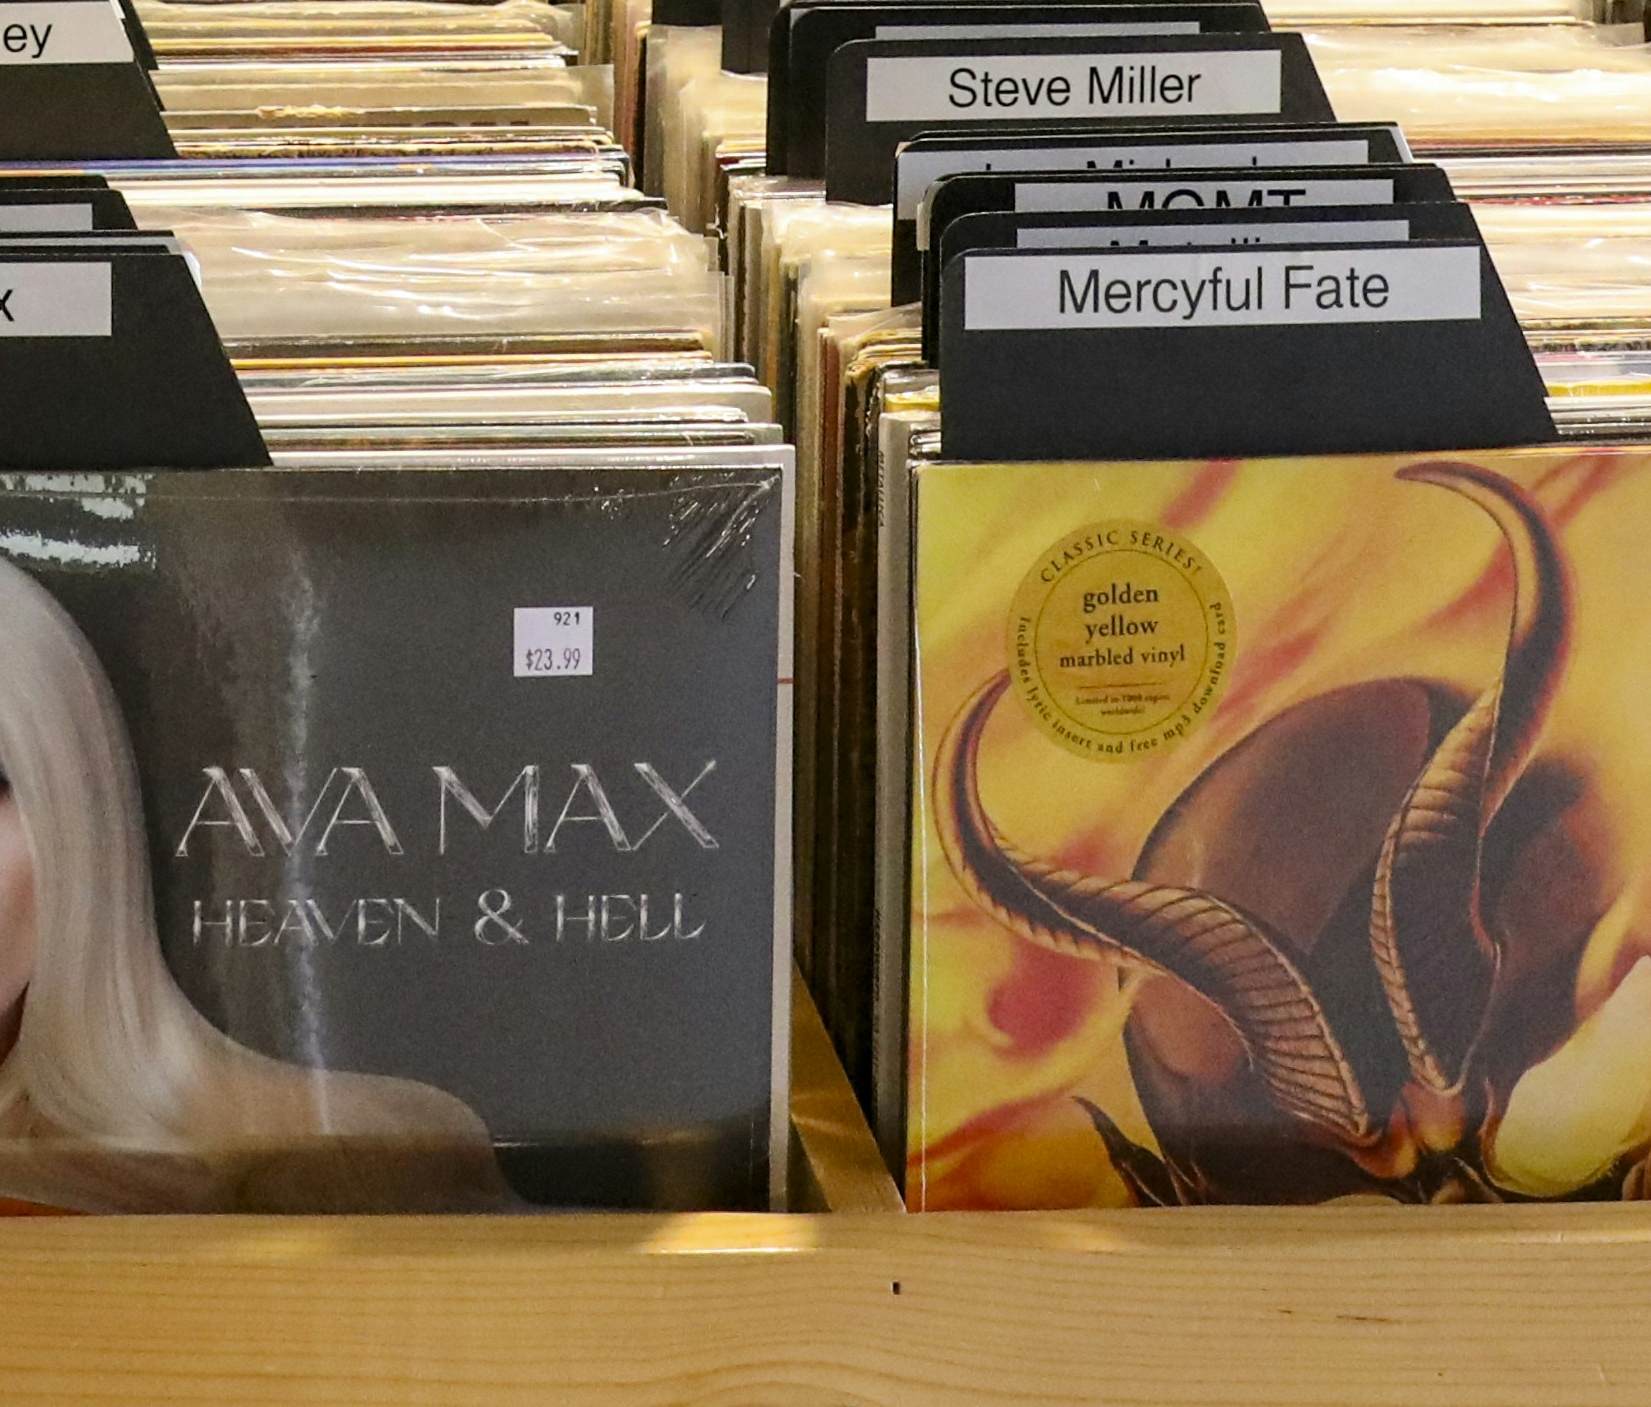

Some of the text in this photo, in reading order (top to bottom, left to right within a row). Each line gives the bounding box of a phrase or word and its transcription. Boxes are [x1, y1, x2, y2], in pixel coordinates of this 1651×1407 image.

[947, 65, 1204, 109] Steve Miller
[1058, 264, 1391, 322] Mercyful Fate
[1039, 529, 1120, 585] CLASSIC
[1081, 582, 1160, 614] golden
[553, 610, 581, 628] 921
[1084, 614, 1160, 645] yellow
[524, 646, 583, 672] $23.99
[1059, 643, 1187, 669] marbled vinyl
[173, 758, 721, 858] AVA MAX
[192, 888, 708, 948] HEAVEN & HELL
